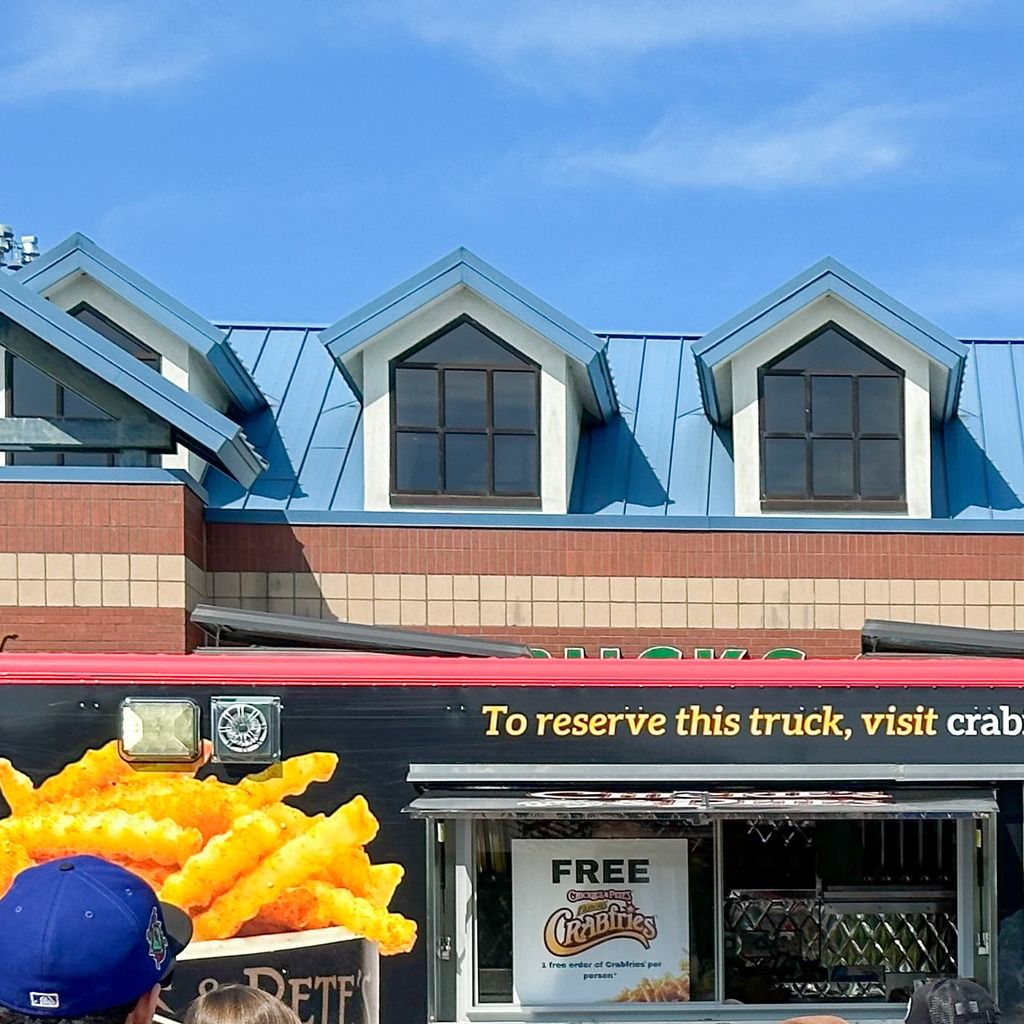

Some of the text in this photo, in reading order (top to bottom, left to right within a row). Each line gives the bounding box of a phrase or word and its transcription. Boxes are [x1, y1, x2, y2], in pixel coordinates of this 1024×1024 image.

[482, 704, 528, 736] To
[535, 706, 667, 736] reserve
[674, 704, 741, 736] this
[748, 704, 851, 741] truck,
[859, 704, 939, 736] visit
[551, 859, 650, 884] FREE
